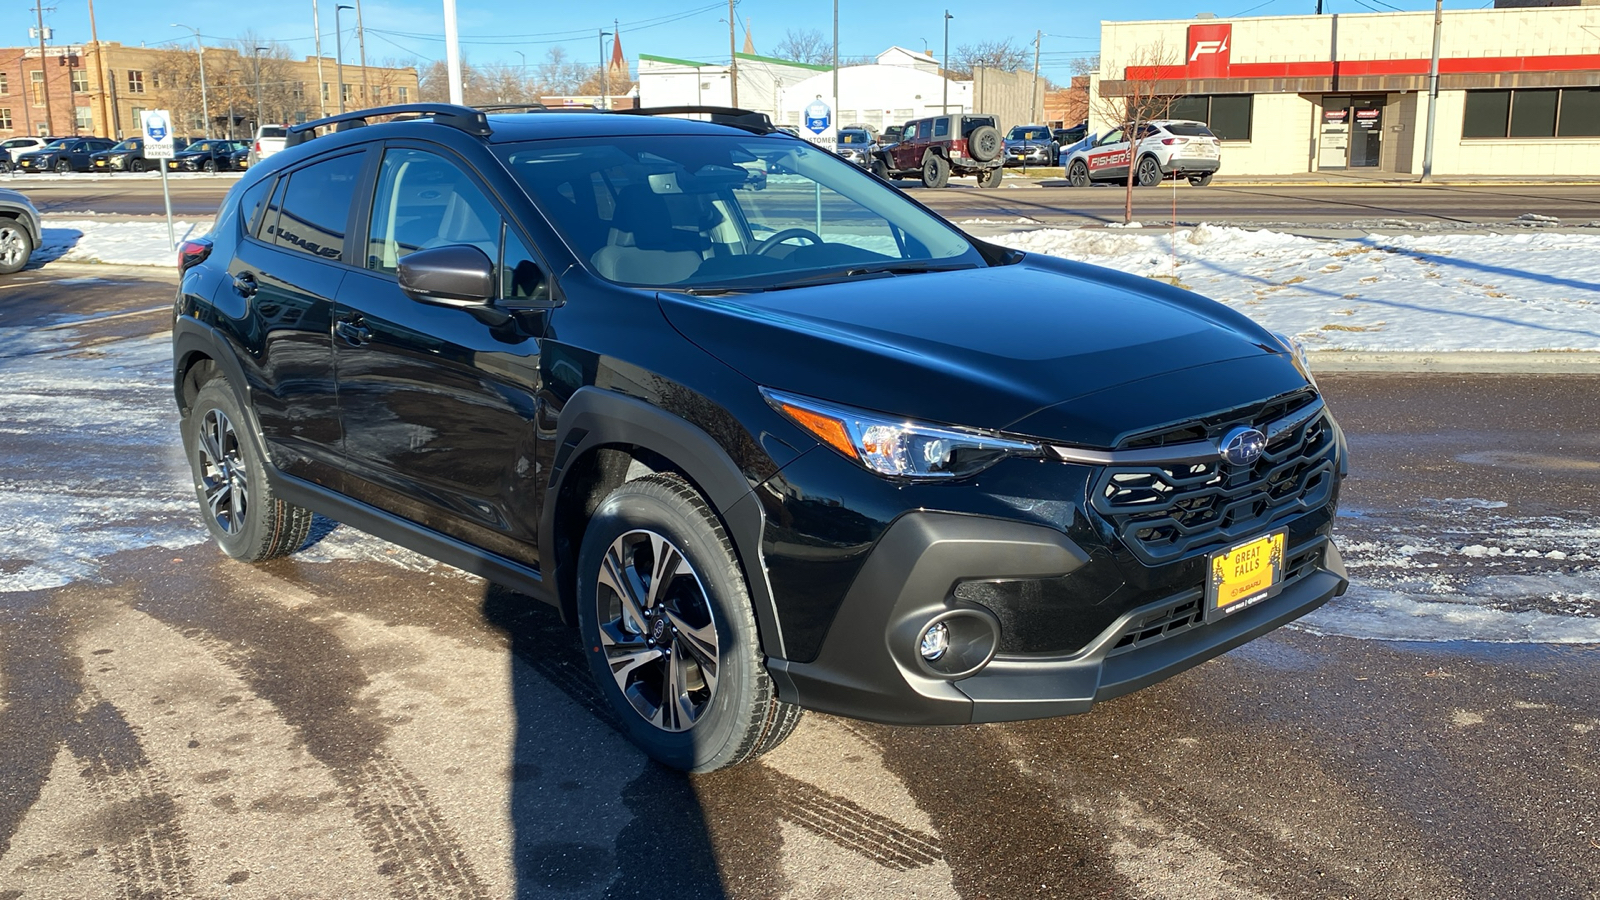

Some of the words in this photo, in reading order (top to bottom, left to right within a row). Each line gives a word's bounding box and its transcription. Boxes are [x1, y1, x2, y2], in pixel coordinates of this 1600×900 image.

[803, 136, 837, 144] STOMER
[1235, 546, 1261, 564] GREAT
[1234, 558, 1260, 578] FALLS
[1238, 579, 1262, 594] SUBARU
